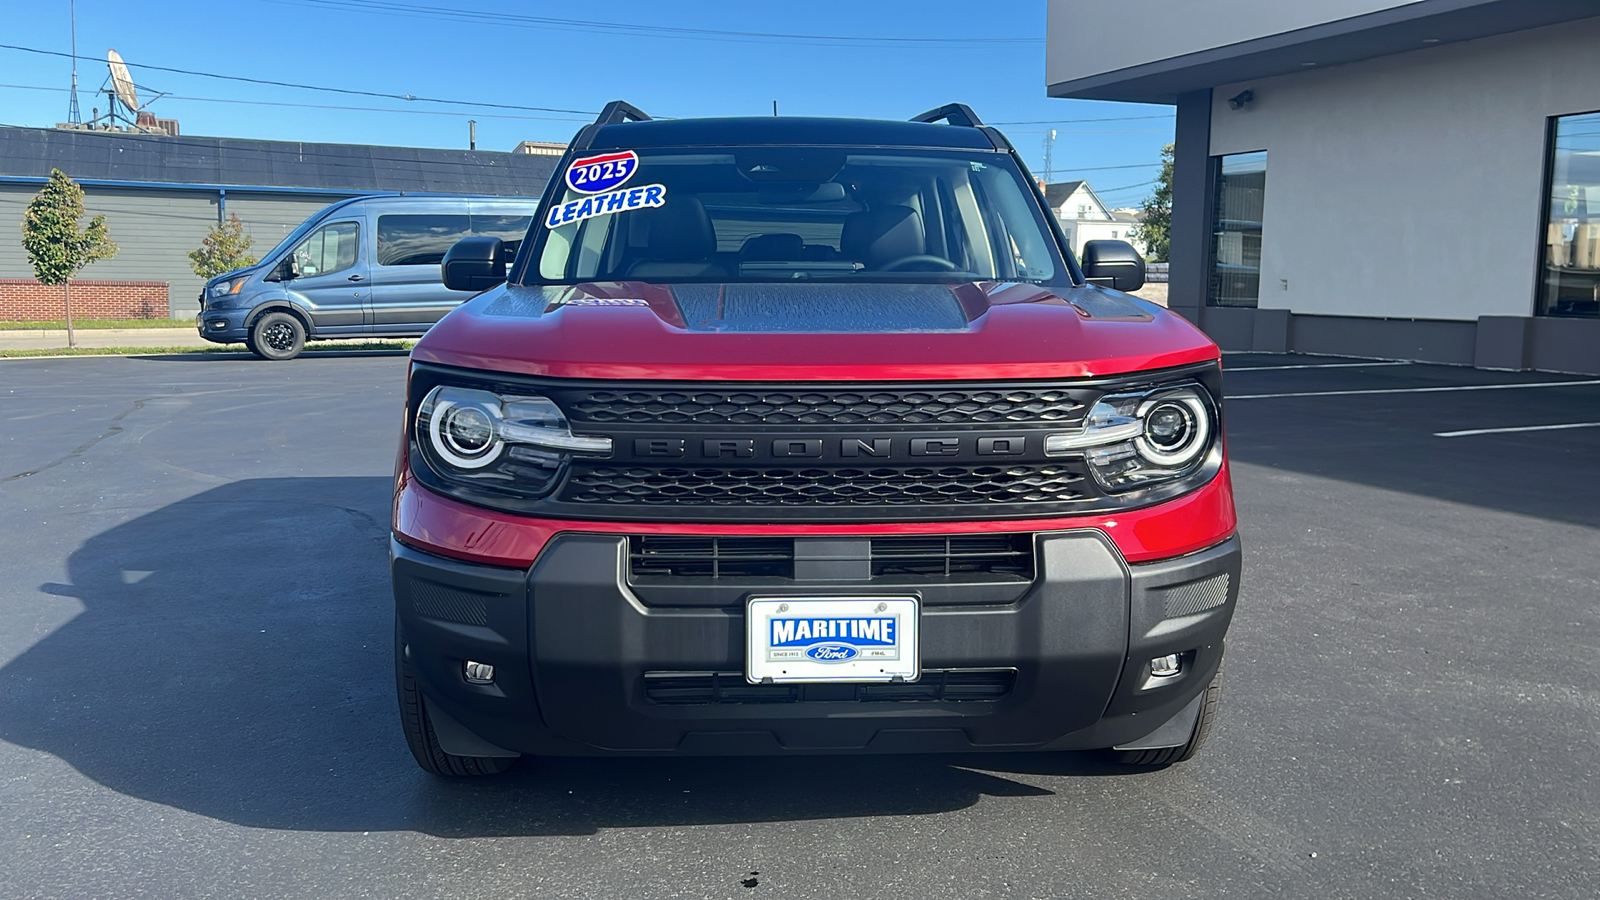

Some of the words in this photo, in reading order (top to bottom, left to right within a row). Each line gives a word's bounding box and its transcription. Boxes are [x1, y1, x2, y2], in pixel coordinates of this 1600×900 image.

[575, 160, 628, 185] 2025
[548, 186, 663, 227] LEATHER
[633, 436, 1026, 459] BRONCO
[772, 619, 894, 646] MARITIME
[814, 646, 849, 660] Ford
